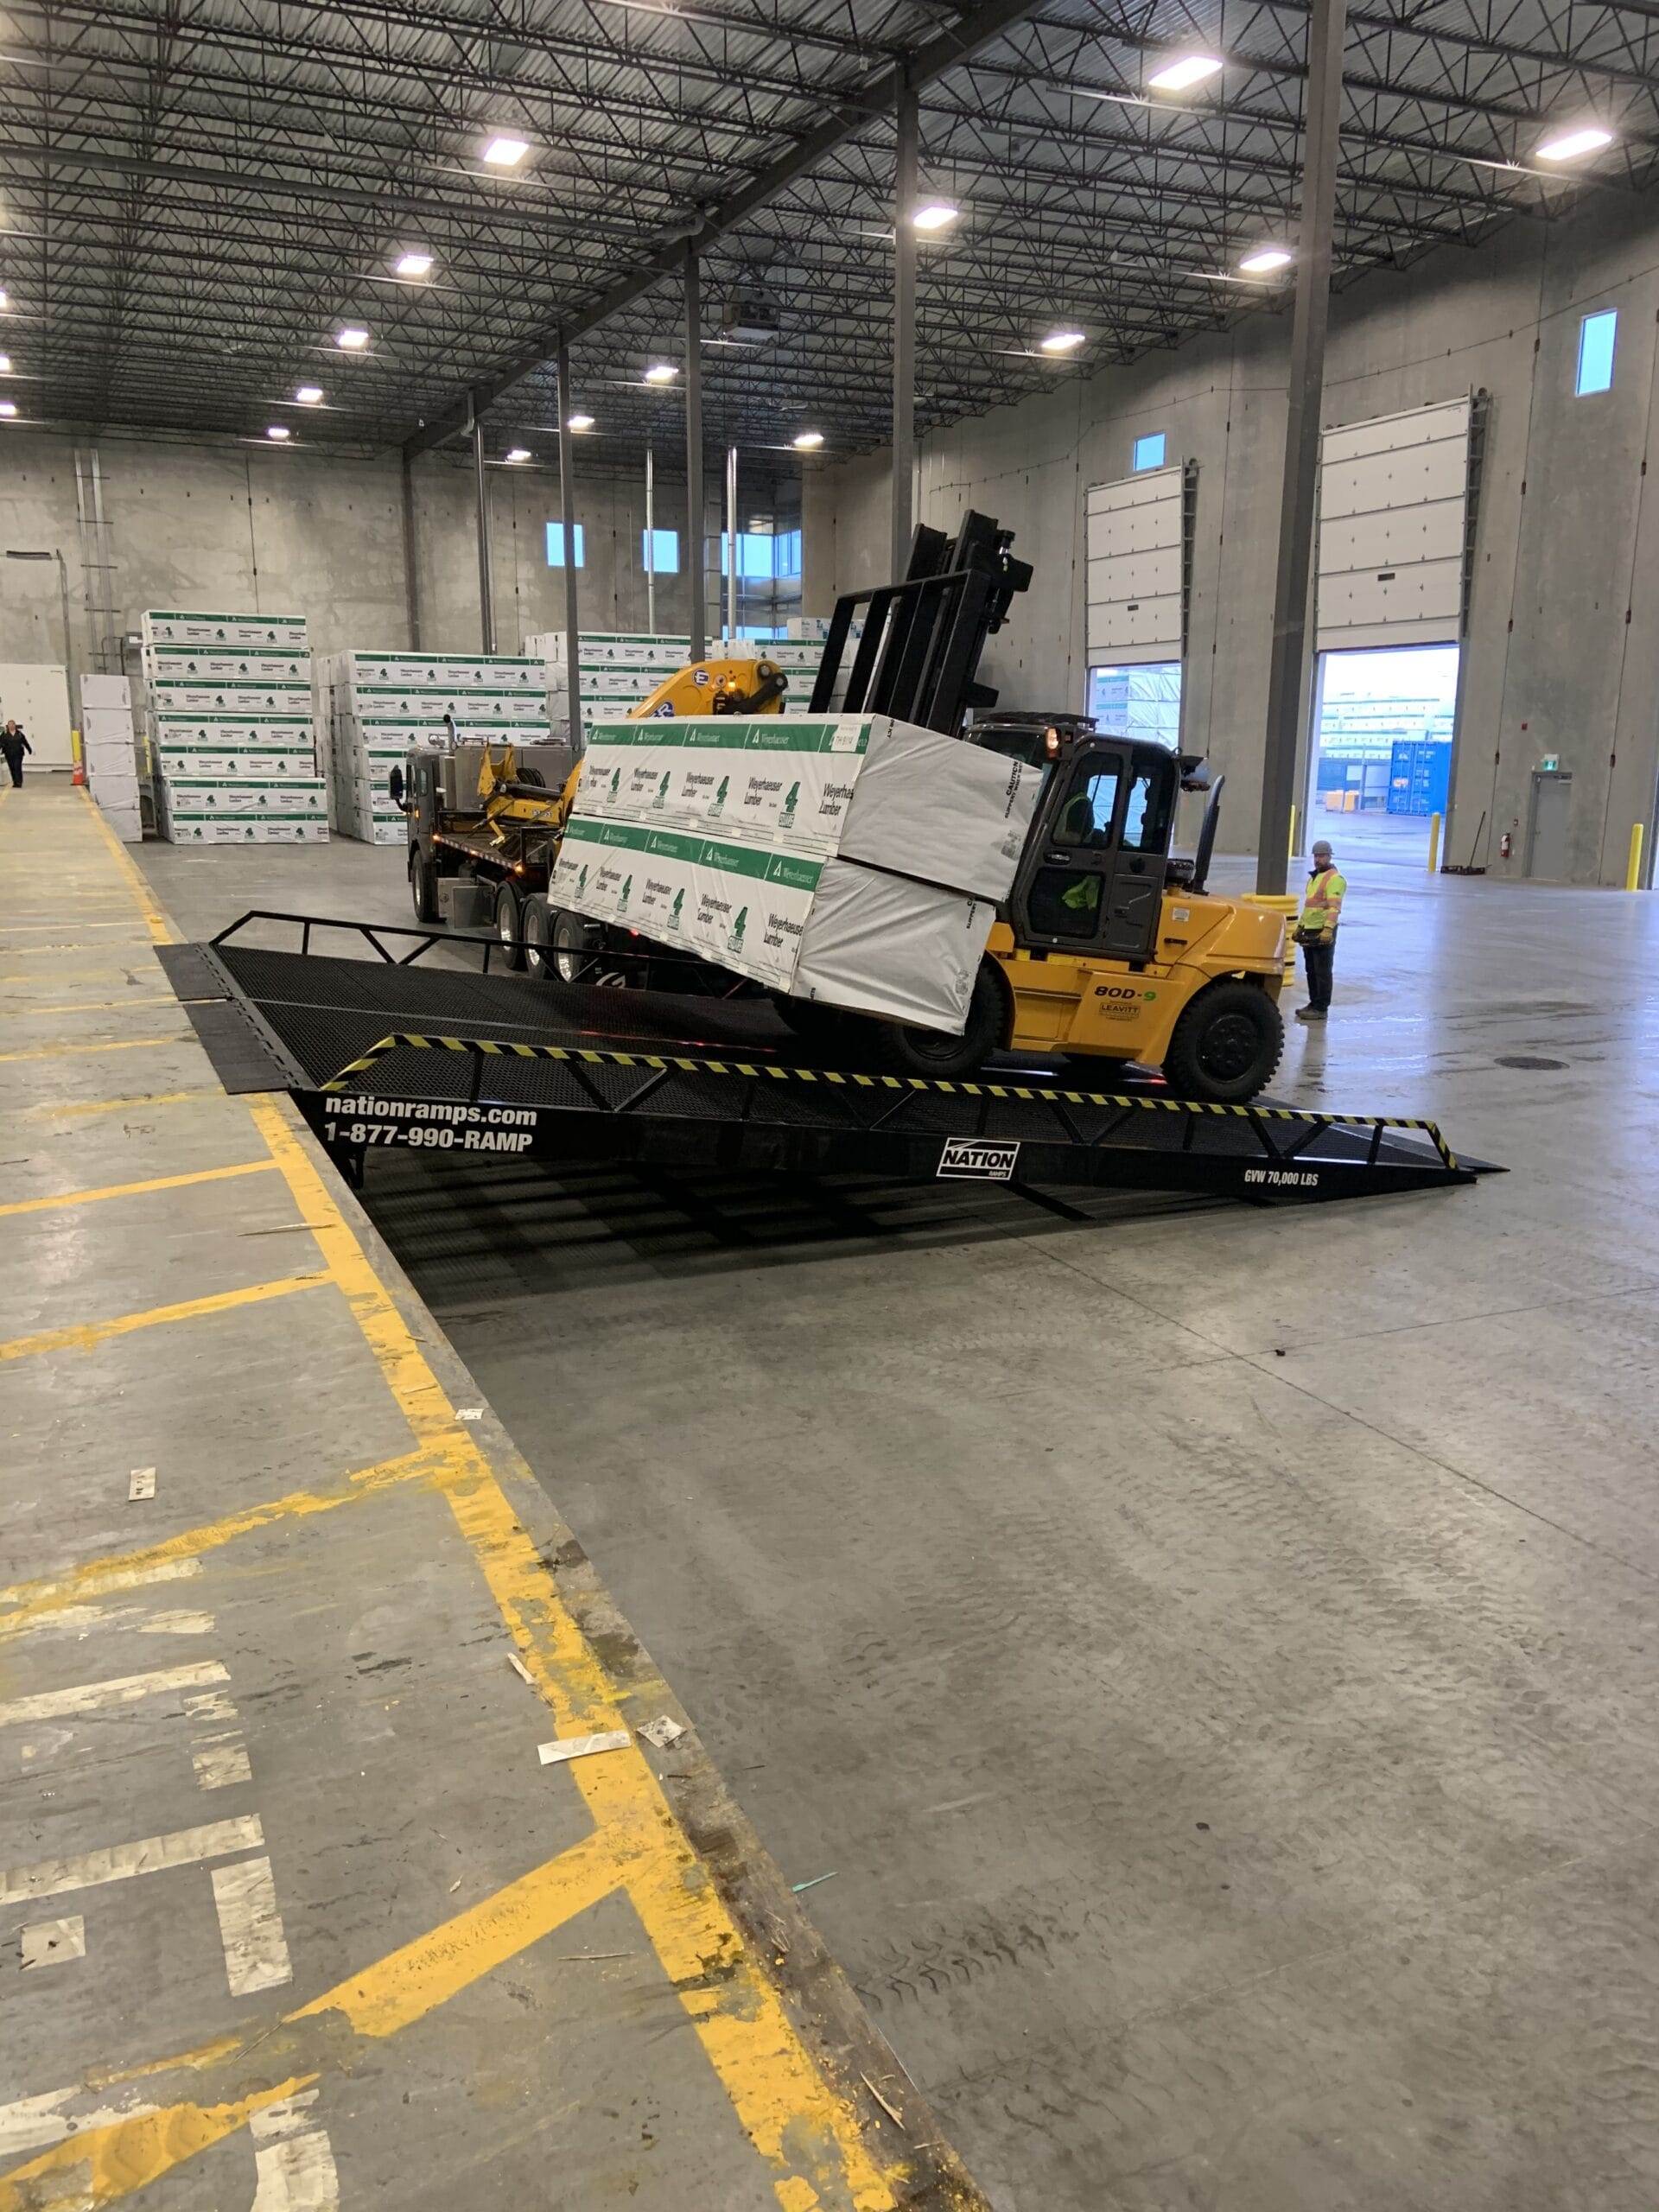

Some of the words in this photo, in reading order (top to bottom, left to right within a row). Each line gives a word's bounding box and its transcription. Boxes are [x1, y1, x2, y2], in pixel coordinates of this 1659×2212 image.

[818, 799, 842, 816] Lumber
[764, 930, 783, 948] Lumber
[1102, 1004, 1139, 1014] LEAVITT
[325, 1096, 537, 1126] nationramps.com
[324, 1122, 533, 1153] 1-877-990-RAMP
[943, 1150, 1015, 1168] NATION
[1244, 1169, 1267, 1183] GVW
[1268, 1170, 1300, 1186] 70,000
[1300, 1173, 1319, 1186] LBS
